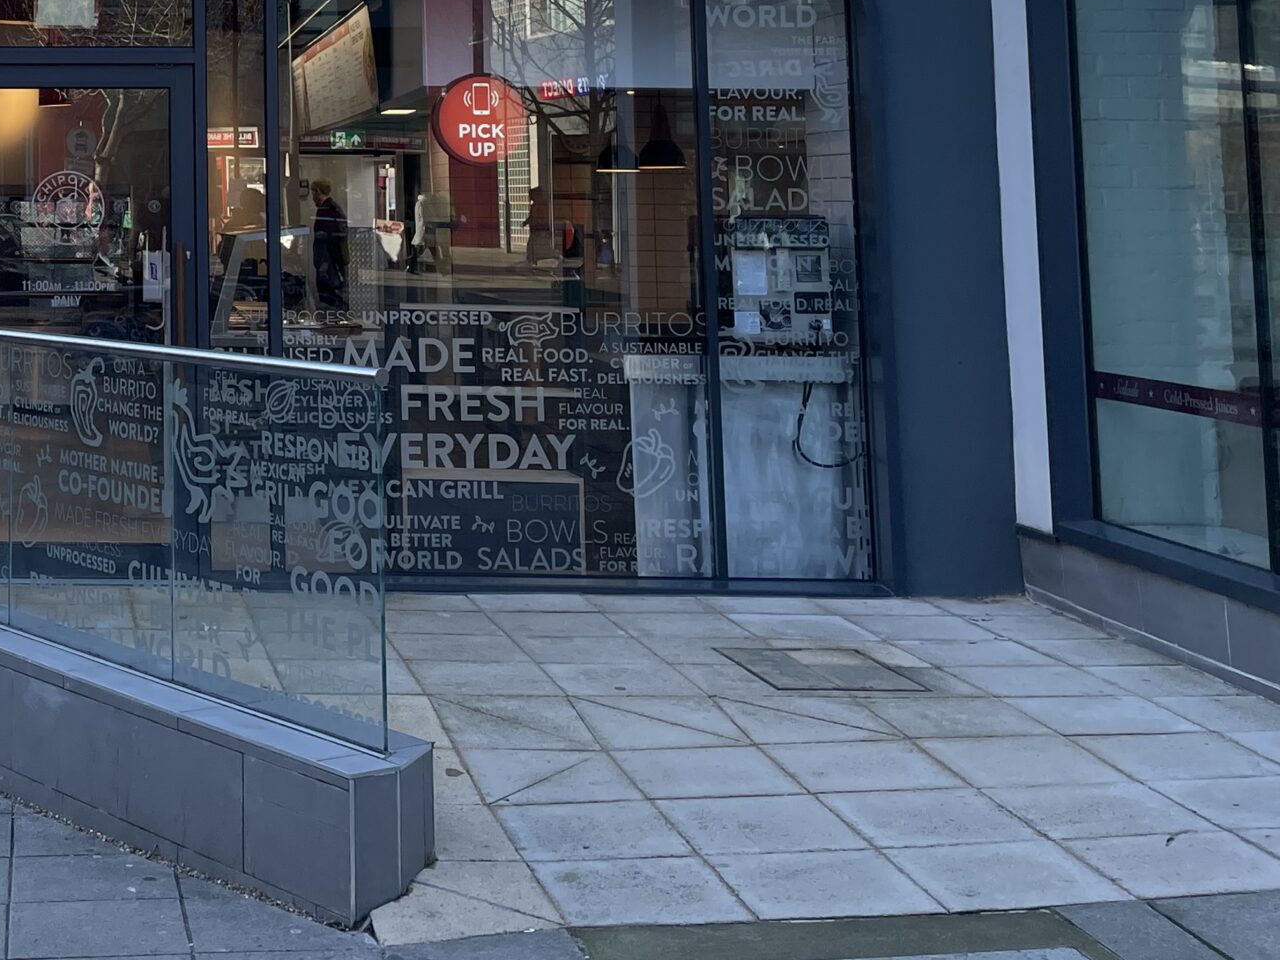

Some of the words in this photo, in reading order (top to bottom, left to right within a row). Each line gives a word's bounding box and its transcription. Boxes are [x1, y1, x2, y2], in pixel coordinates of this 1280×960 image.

[706, 5, 817, 28] WORLD
[709, 106, 746, 121] FOR
[752, 106, 806, 121] REAL.
[458, 123, 505, 139] PICK
[469, 141, 496, 158] UP
[22, 280, 62, 291] 11:00AM
[53, 295, 81, 307] DAILY
[718, 298, 755, 310] REAL
[362, 311, 493, 325] UNPROCESSED
[561, 312, 707, 336] BURRITOS
[343, 337, 476, 373] MADE
[482, 348, 528, 363] REAL
[534, 348, 593, 364] FOOD.
[599, 343, 608, 353] A
[613, 342, 703, 354] SUSTAINABLE
[113, 358, 136, 374] CAN
[137, 363, 145, 376] A
[610, 358, 680, 370] CYLINDER
[502, 368, 544, 382] REAL
[548, 368, 592, 382] FAST.
[598, 373, 707, 385] DELICIOUSNESS
[103, 376, 157, 399] BURRITO
[574, 388, 608, 400] REAL
[14, 395, 54, 414] CYLINDER
[97, 397, 140, 419] CHANGE
[143, 404, 163, 421] THE
[293, 395, 363, 407] CYLINDER
[401, 384, 545, 422] FRESH
[559, 402, 624, 415] FLAVOUR
[1163, 389, 1213, 411] Cold-Pressed
[7, 411, 69, 433] ELICIOUSNESS
[203, 407, 223, 421] FOR
[288, 411, 393, 424] ELICIOUSNESS
[108, 419, 159, 443] WORLD?
[558, 418, 587, 431] FOR
[591, 418, 630, 431] REAL.
[337, 432, 577, 470] EVERYDAY
[59, 448, 107, 472] MOTHER
[111, 458, 158, 483] NATURE
[250, 460, 306, 483] MEXICAN
[440, 480, 504, 499] GRILL
[512, 494, 612, 513] BURRITOS
[54, 502, 92, 527] MADE
[95, 511, 138, 535] FRESH
[383, 515, 461, 530] ULTIVATE
[391, 534, 452, 547] BETTER
[507, 519, 609, 544] BOWLS
[47, 543, 116, 574] UNPROCESSED
[383, 551, 463, 569] WORLD
[478, 547, 585, 571] SALADS
[600, 560, 627, 572] FOR
[235, 564, 261, 585] FOR
[290, 566, 380, 608] GOOD
